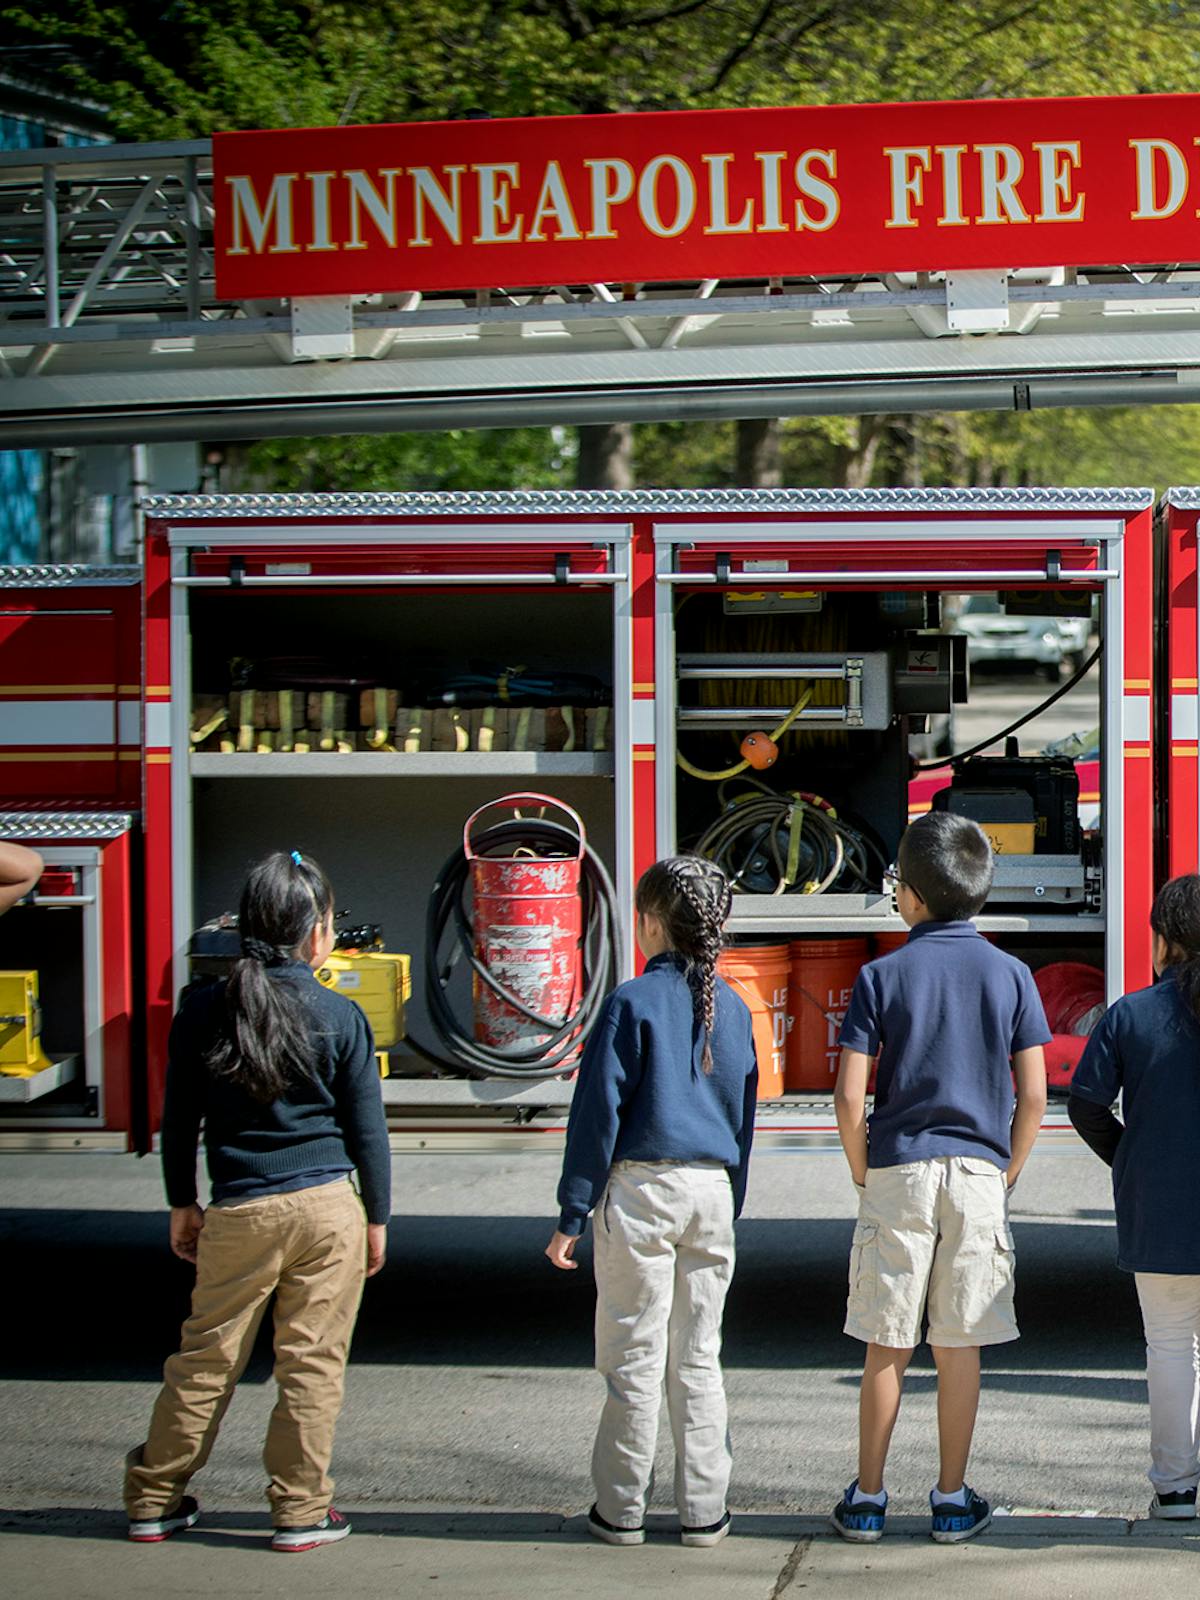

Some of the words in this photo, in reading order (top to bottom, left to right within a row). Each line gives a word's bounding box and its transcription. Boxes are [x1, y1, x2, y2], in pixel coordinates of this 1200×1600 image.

[226, 149, 840, 254] MINNEAPOLIS
[883, 141, 1085, 228] FIRE
[828, 987, 854, 1008] LE
